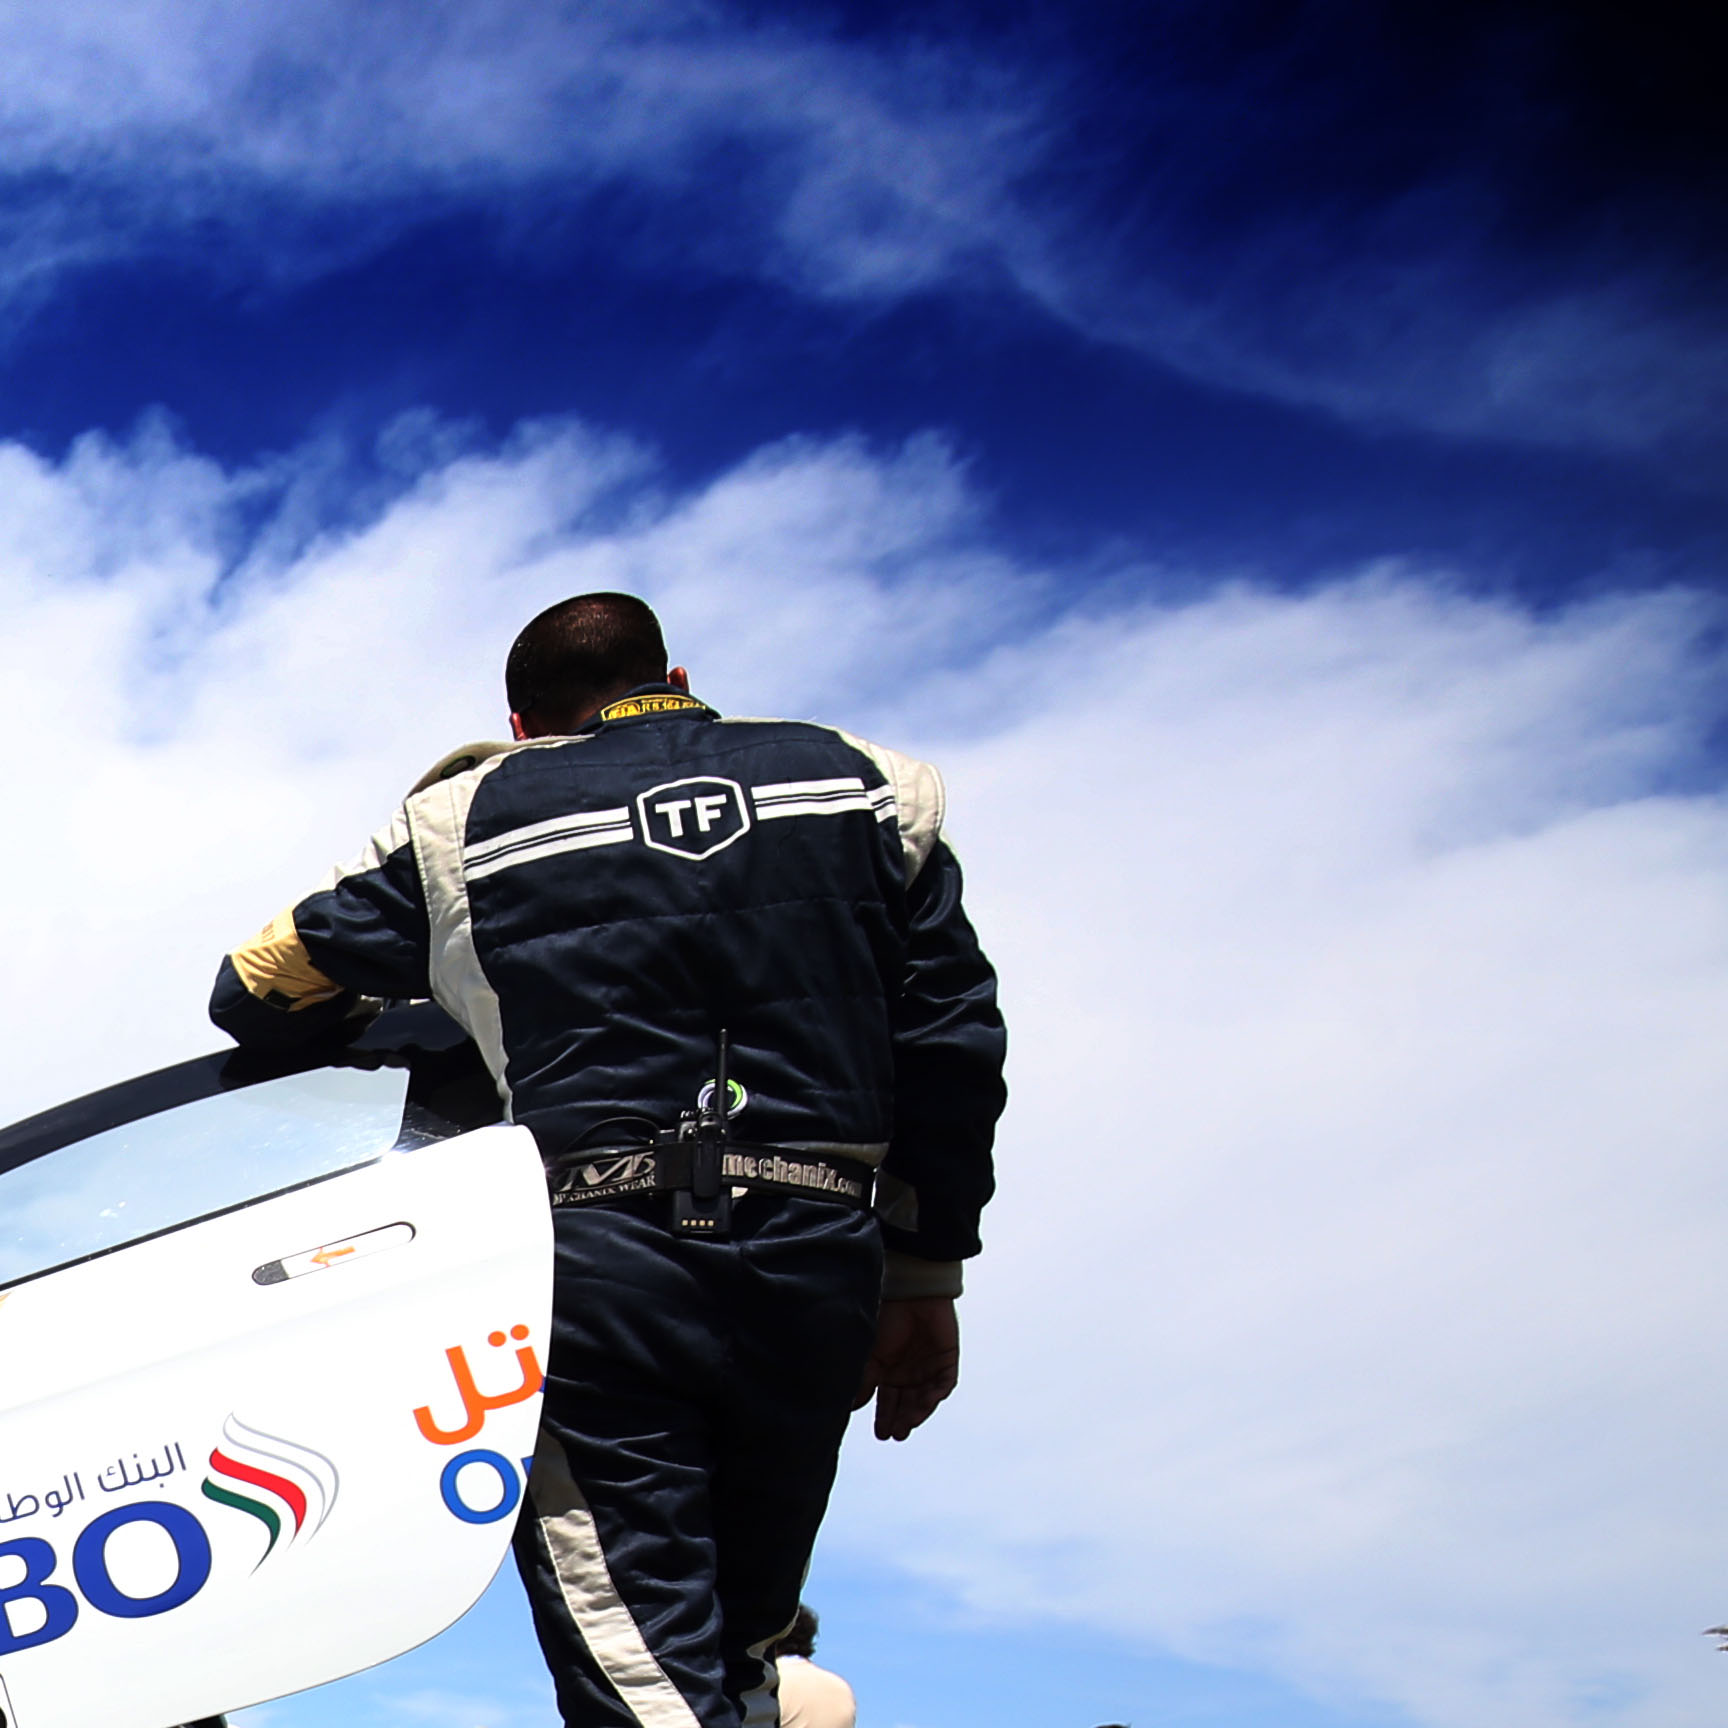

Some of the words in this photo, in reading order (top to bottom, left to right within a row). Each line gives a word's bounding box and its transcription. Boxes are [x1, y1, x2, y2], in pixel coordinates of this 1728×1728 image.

[655, 794, 727, 838] TF
[619, 1173, 656, 1191] WEAR
[96, 1442, 188, 1493] البنك
